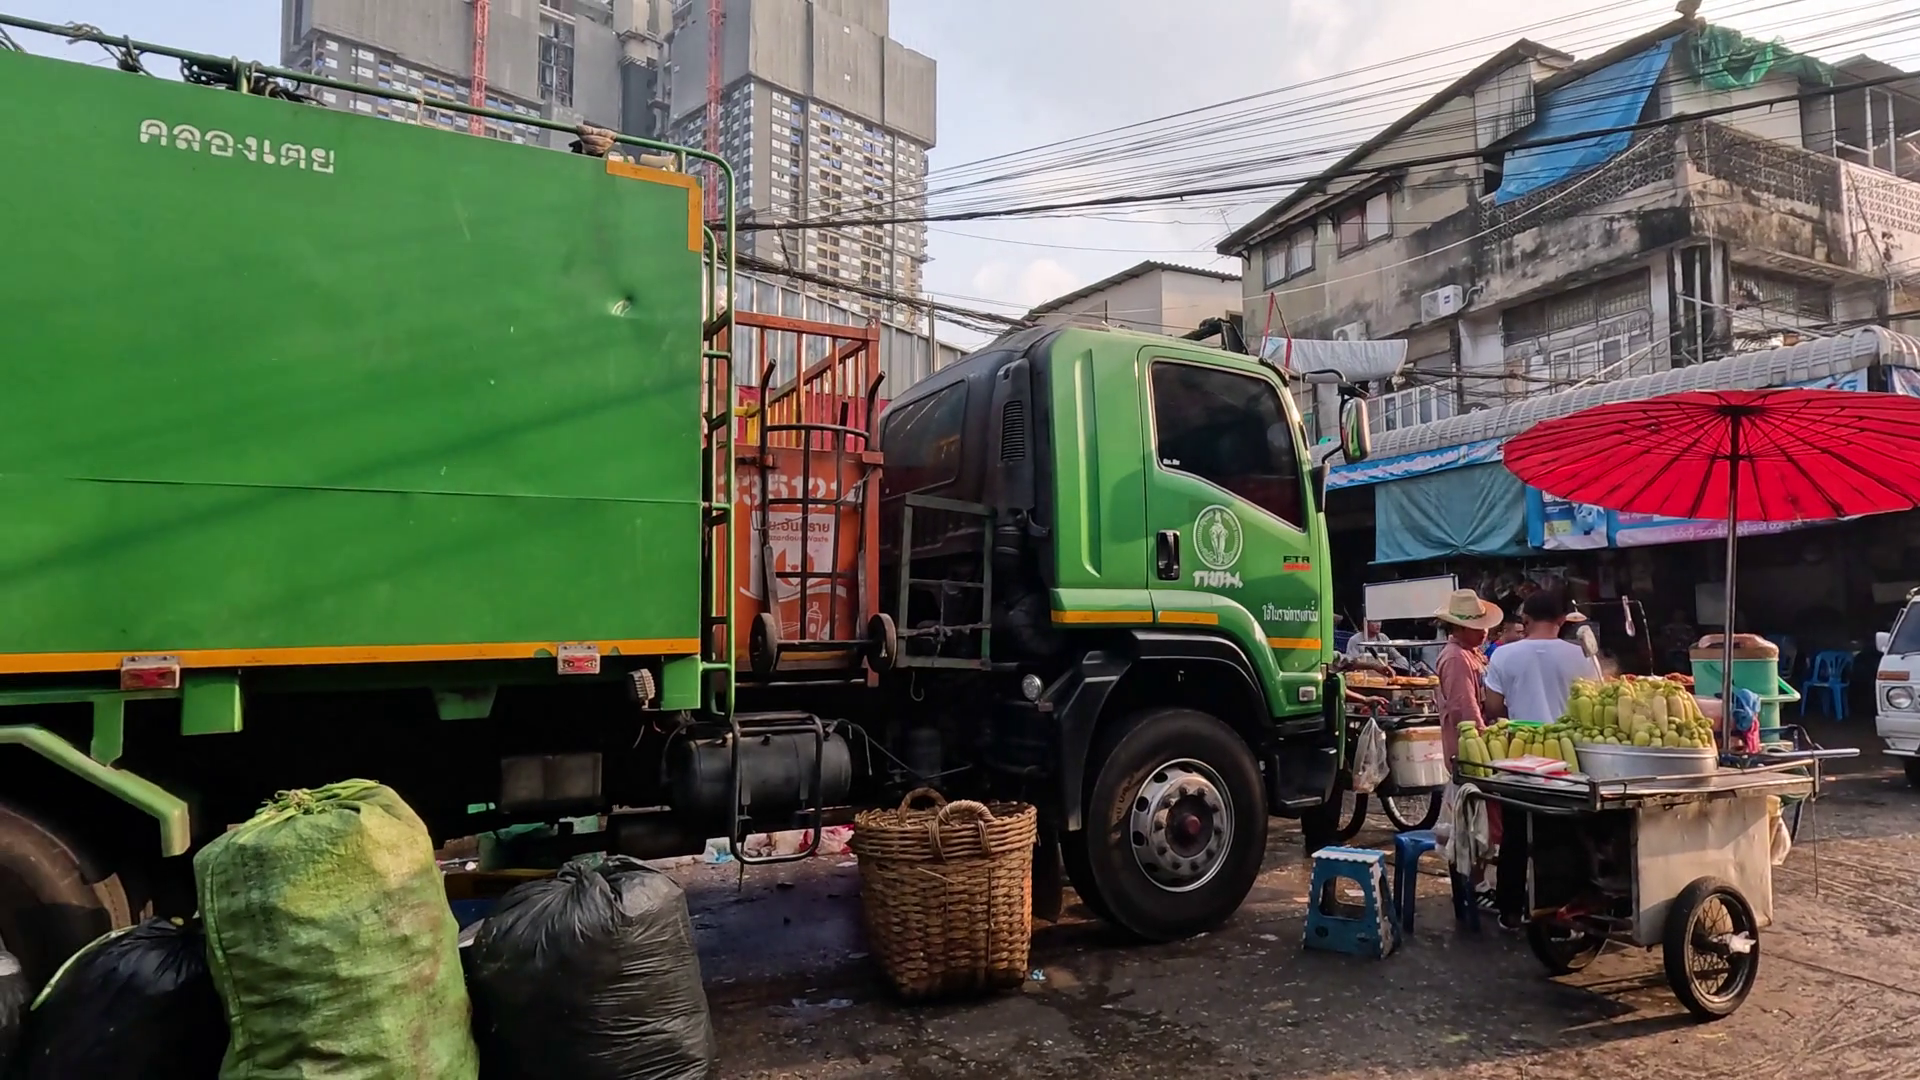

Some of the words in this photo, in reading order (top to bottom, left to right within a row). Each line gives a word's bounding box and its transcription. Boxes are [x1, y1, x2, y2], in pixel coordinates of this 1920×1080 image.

[139, 118, 336, 174] คลองเตย
[768, 517, 830, 533] ยะอันราย
[1283, 555, 1310, 564] FTR
